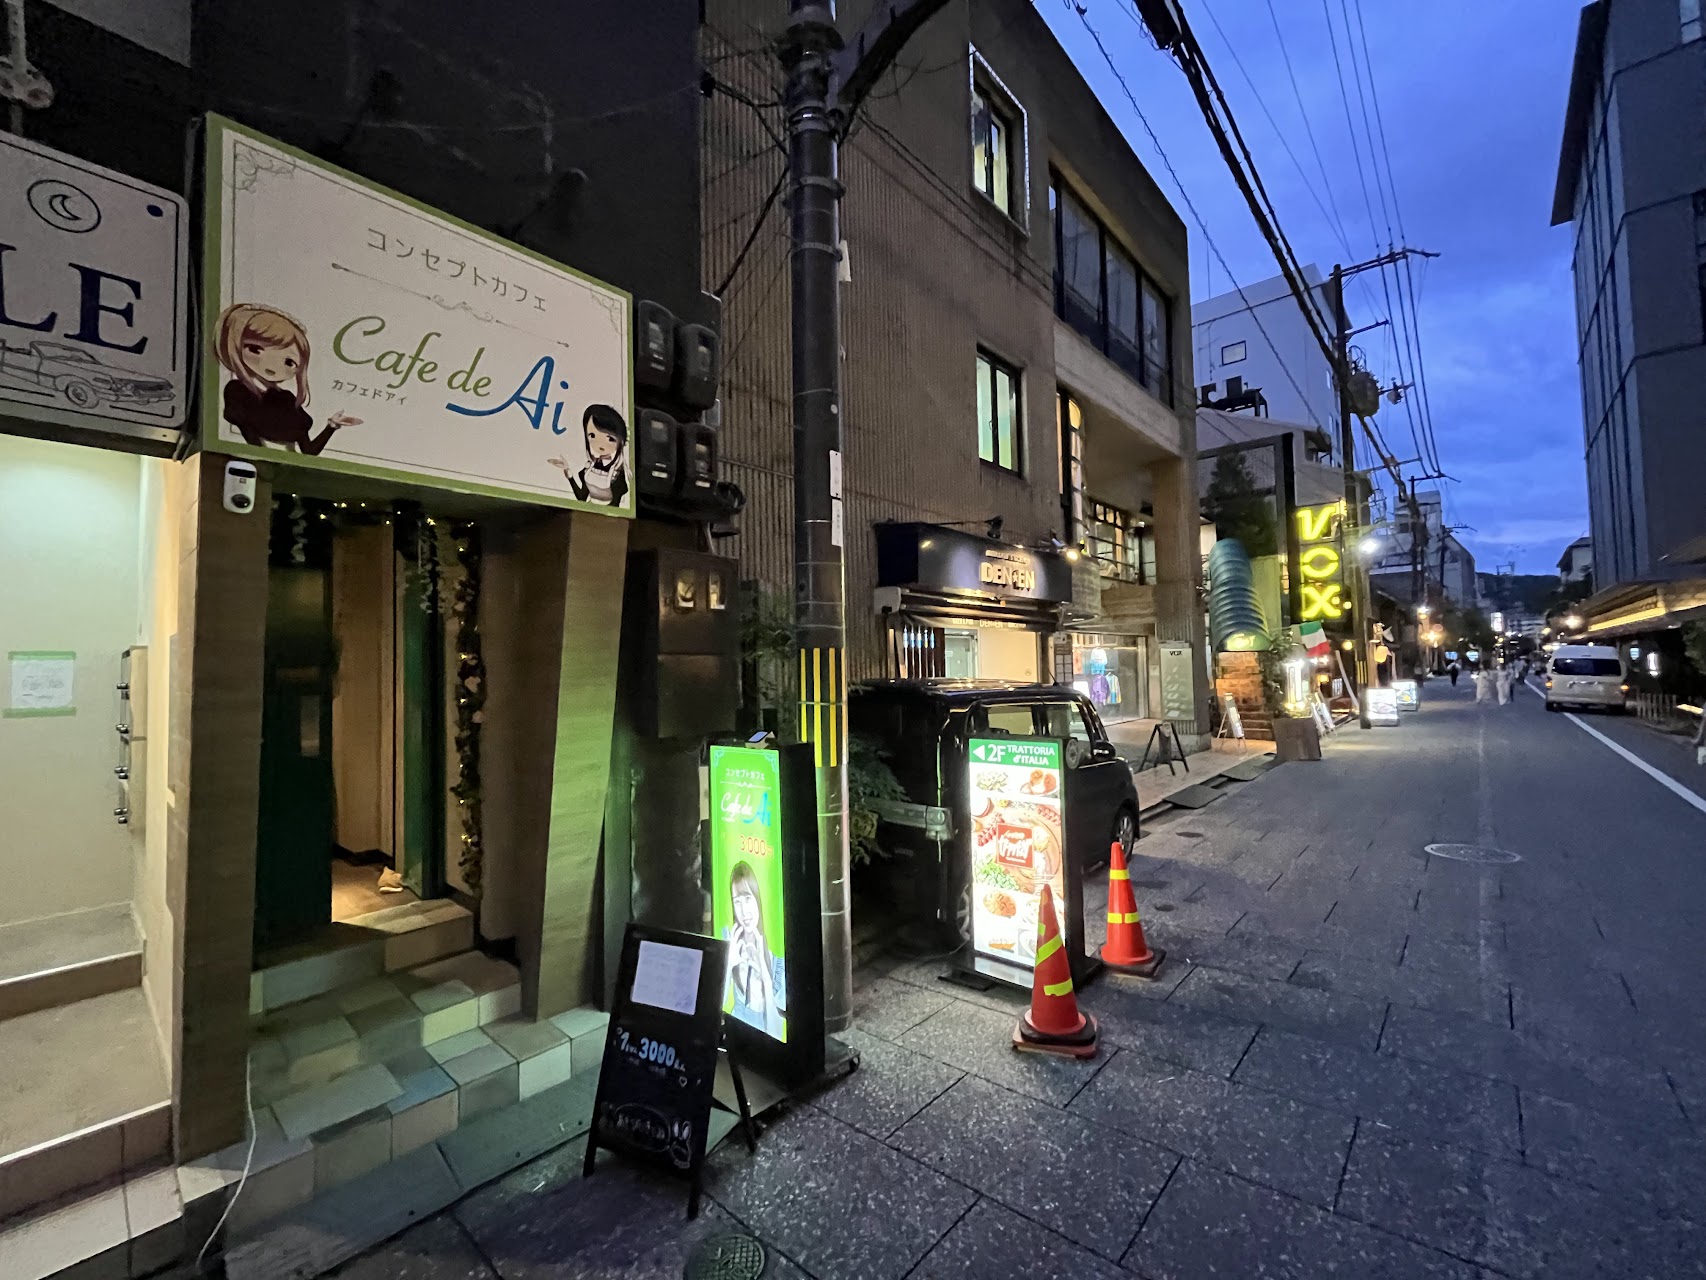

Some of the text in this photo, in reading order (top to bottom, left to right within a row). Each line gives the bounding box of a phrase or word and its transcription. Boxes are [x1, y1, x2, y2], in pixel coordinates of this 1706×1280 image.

[367, 227, 547, 312] コンセプトカフェ
[332, 316, 569, 435] Cafe de Ai
[332, 378, 407, 406] カフェドアイ
[1296, 505, 1342, 618] VOX
[987, 743, 1055, 763] 2F TRATTORIA
